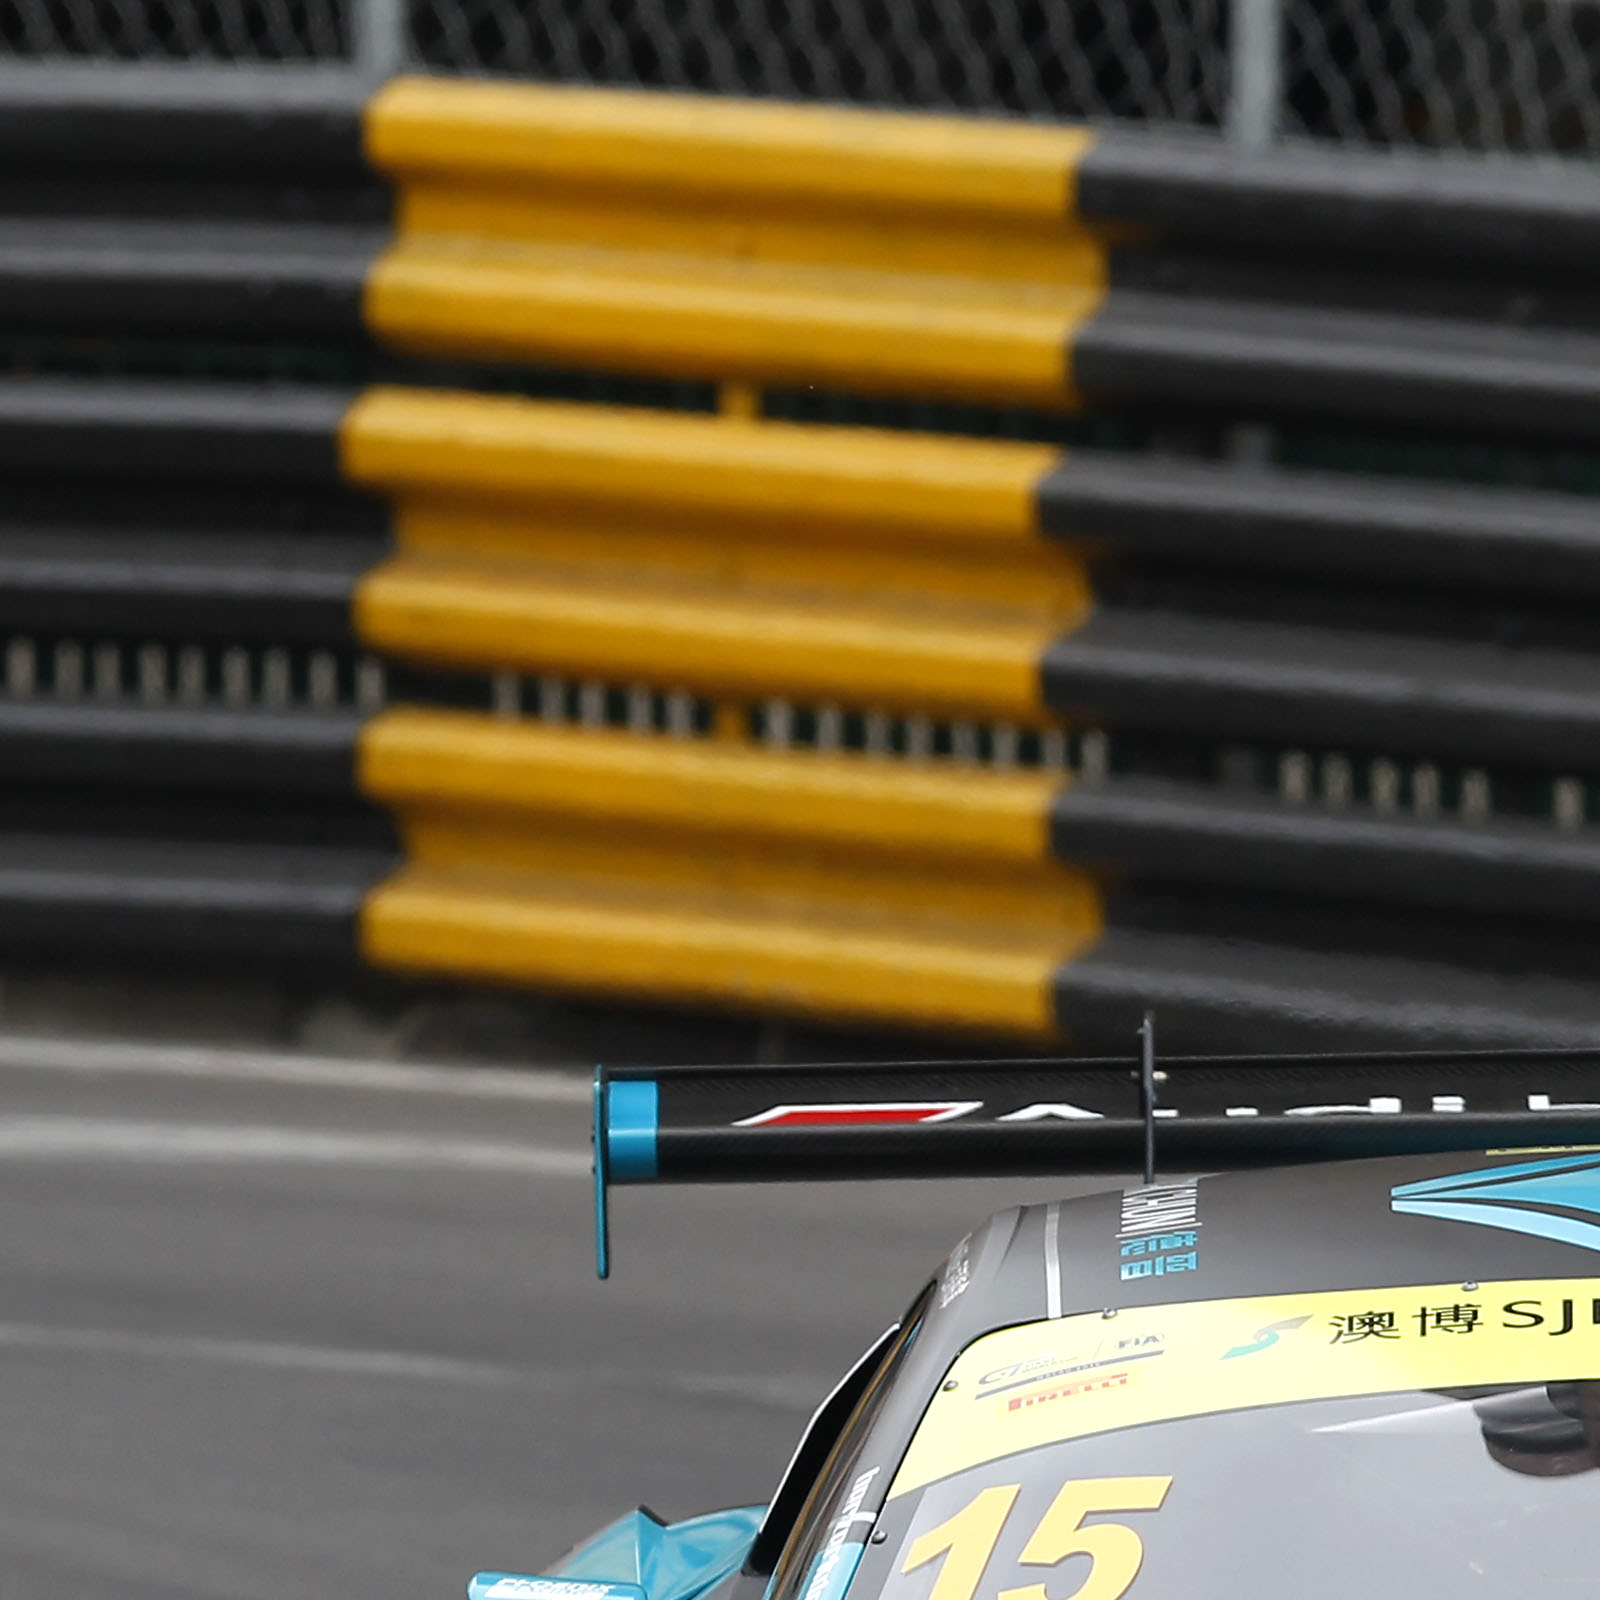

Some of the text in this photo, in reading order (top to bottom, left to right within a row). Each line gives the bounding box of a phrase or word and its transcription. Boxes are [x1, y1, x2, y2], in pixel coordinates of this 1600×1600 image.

[1118, 1333, 1164, 1350] FIA
[1329, 1303, 1484, 1344] 澳博
[1008, 1373, 1128, 1412] PIRELLI
